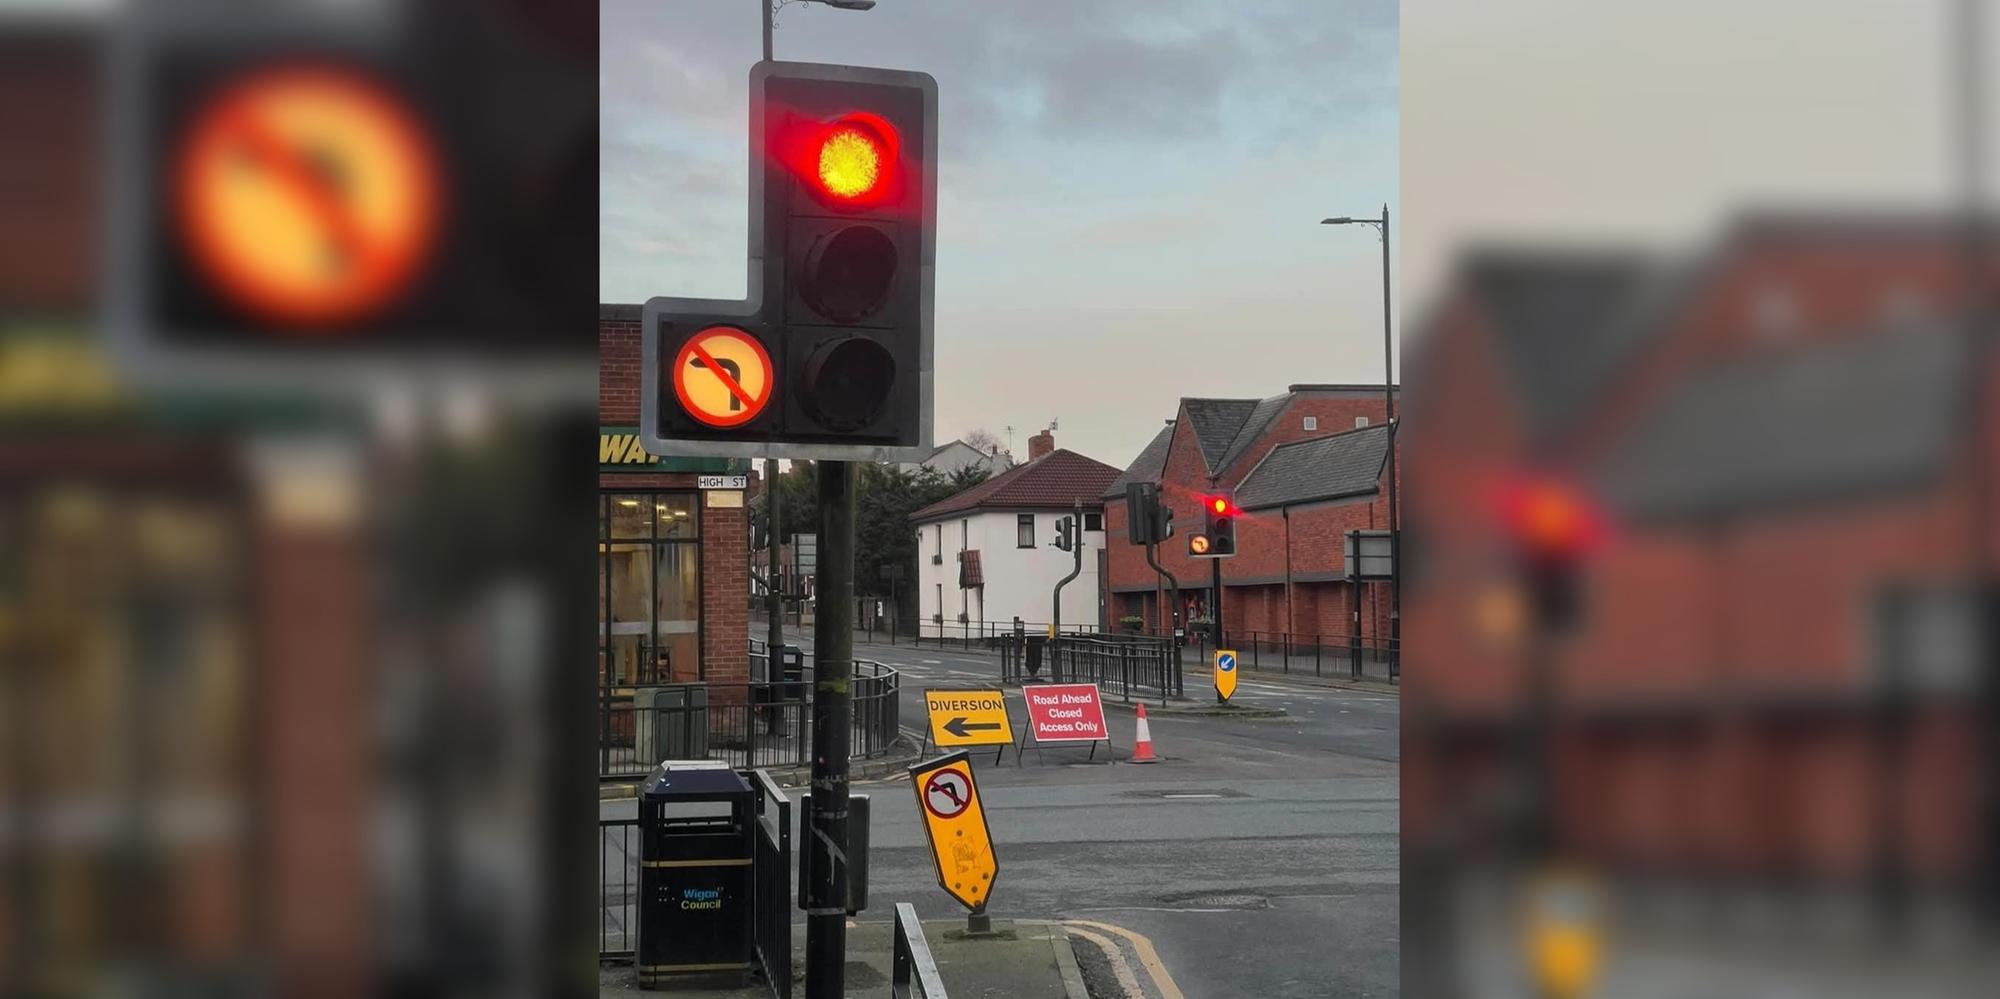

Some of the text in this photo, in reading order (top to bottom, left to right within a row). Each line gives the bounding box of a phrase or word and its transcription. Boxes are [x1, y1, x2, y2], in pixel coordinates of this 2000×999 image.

[600, 434, 659, 464] WA
[700, 477, 745, 487] HIGH ST
[1033, 693, 1092, 705] Road Ahead
[930, 699, 1003, 712] DIVERSION
[1048, 707, 1083, 718] Closed
[1039, 721, 1098, 733] Access Only
[684, 889, 719, 901] Wigan
[681, 899, 721, 910] Council
